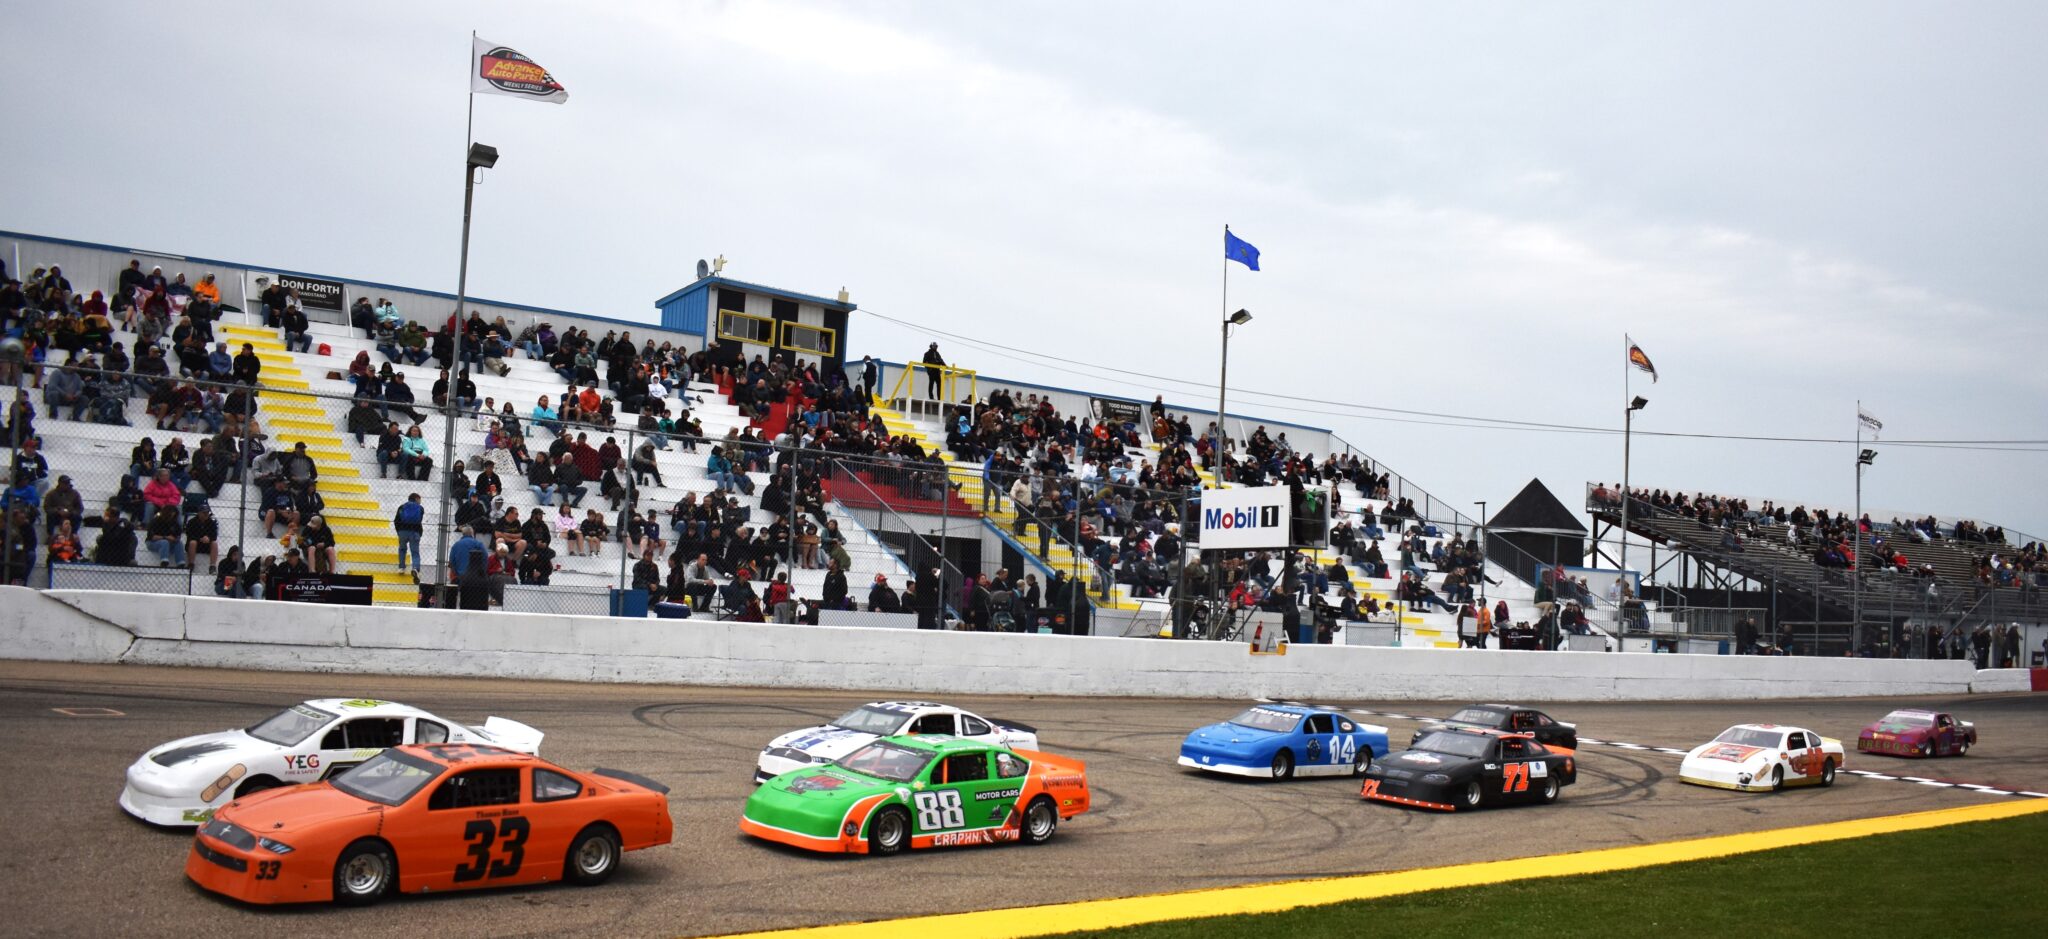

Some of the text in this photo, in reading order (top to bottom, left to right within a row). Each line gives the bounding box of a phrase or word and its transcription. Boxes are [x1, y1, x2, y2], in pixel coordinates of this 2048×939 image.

[487, 69, 543, 82] Auto Parts
[494, 61, 543, 75] Advance
[524, 82, 542, 91] SERIES
[281, 279, 340, 295] DON FORTH
[1205, 506, 1257, 530] Mobil
[1329, 734, 1356, 764] 14
[284, 754, 320, 769] YEG
[1503, 762, 1529, 793] 71
[975, 789, 1019, 801] MOTOR CARS
[914, 789, 965, 831] 88
[453, 817, 530, 882] 33
[256, 860, 281, 880] 33
